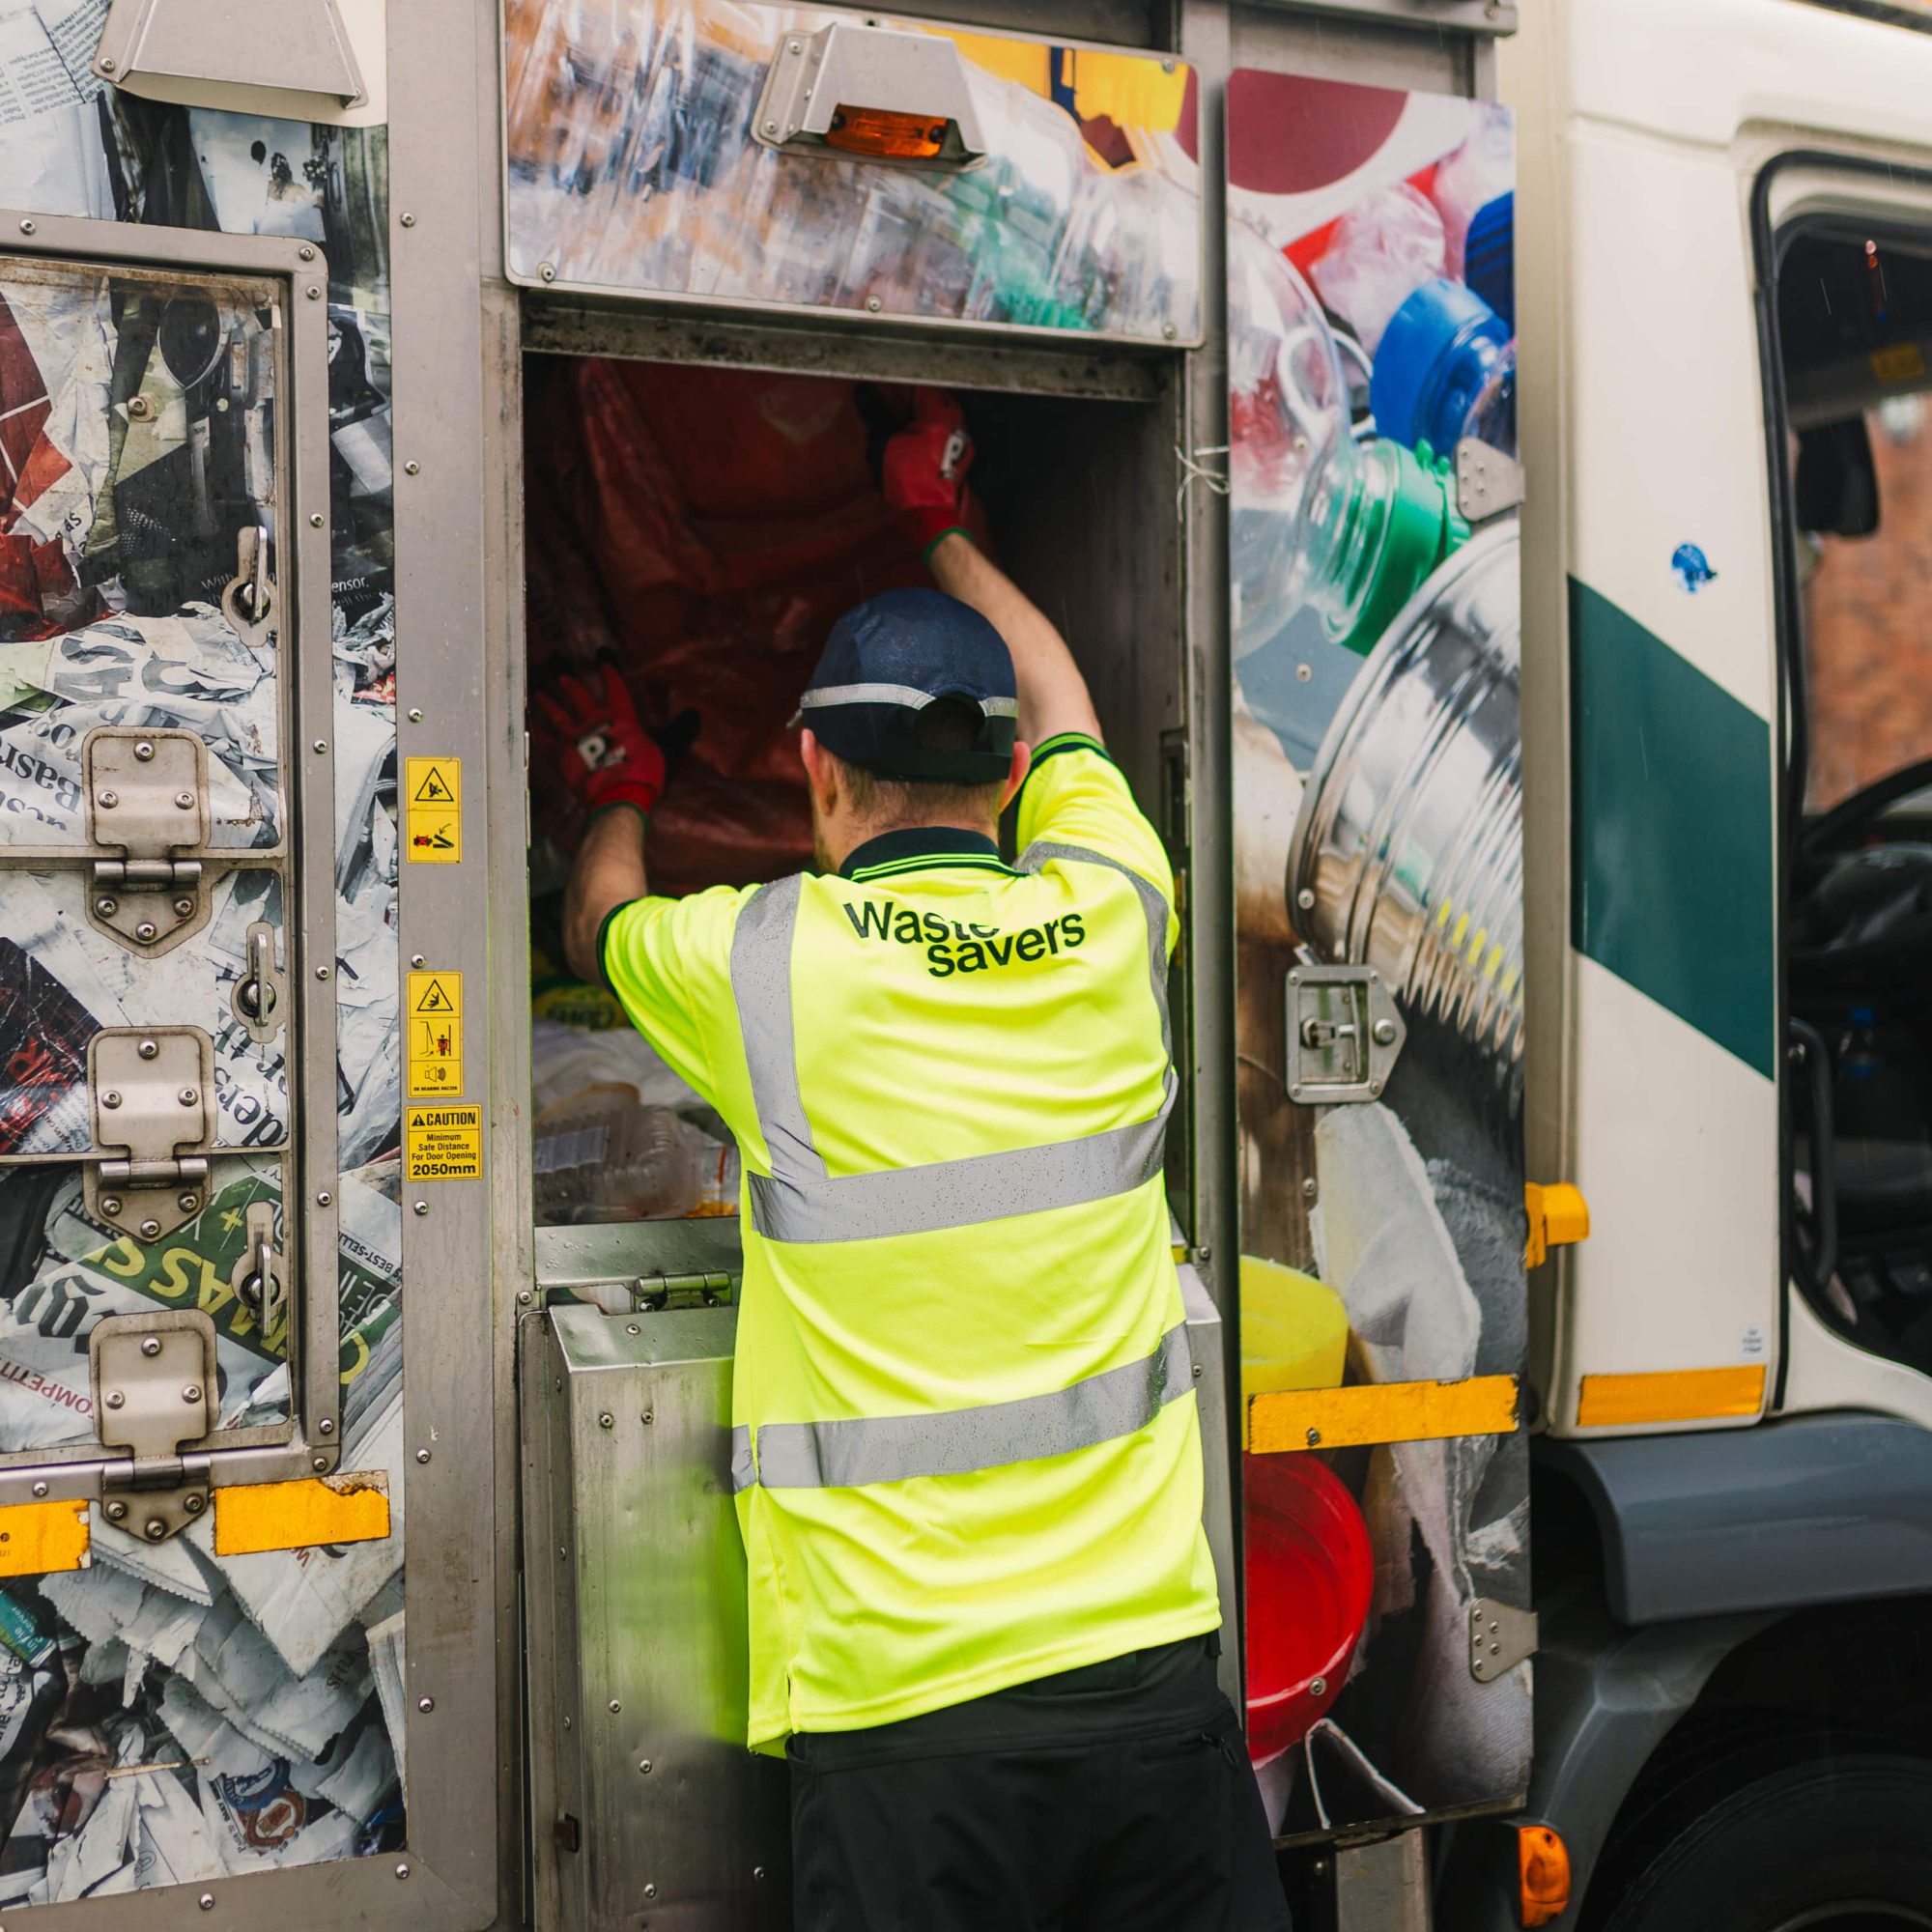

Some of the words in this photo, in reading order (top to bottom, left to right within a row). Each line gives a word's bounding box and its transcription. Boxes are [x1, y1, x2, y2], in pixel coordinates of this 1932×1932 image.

[927, 913, 1086, 978] savers
[426, 1112, 476, 1126] CAUTION
[426, 1133, 462, 1142] Minimum
[418, 1143, 435, 1151] Safe
[438, 1142, 469, 1151] Distance
[446, 1151, 477, 1161] Opening
[412, 1163, 476, 1176] 2050mm
[339, 1231, 393, 1274] BEST-SELLI
[0, 1358, 94, 1419] OMPETIT
